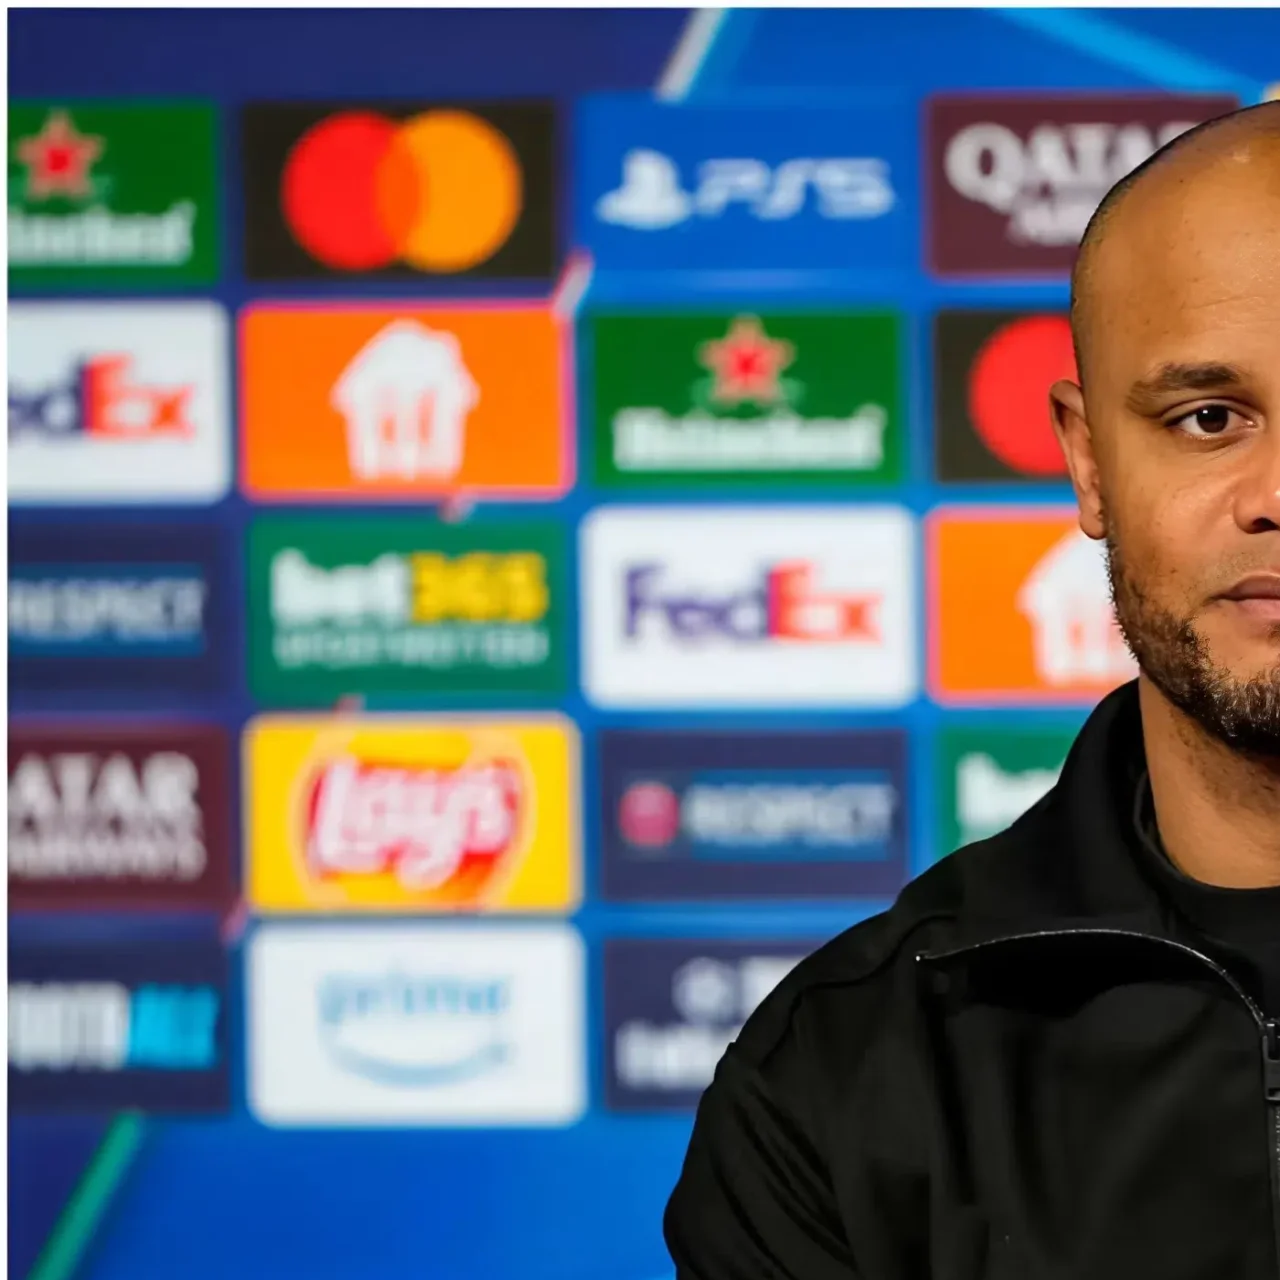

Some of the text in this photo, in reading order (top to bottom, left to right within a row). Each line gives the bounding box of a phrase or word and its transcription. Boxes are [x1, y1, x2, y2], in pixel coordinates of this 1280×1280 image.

[692, 157, 895, 220] PS5
[612, 404, 888, 472] Heineken
[270, 547, 550, 623] bet365
[622, 560, 883, 645] FedEx
